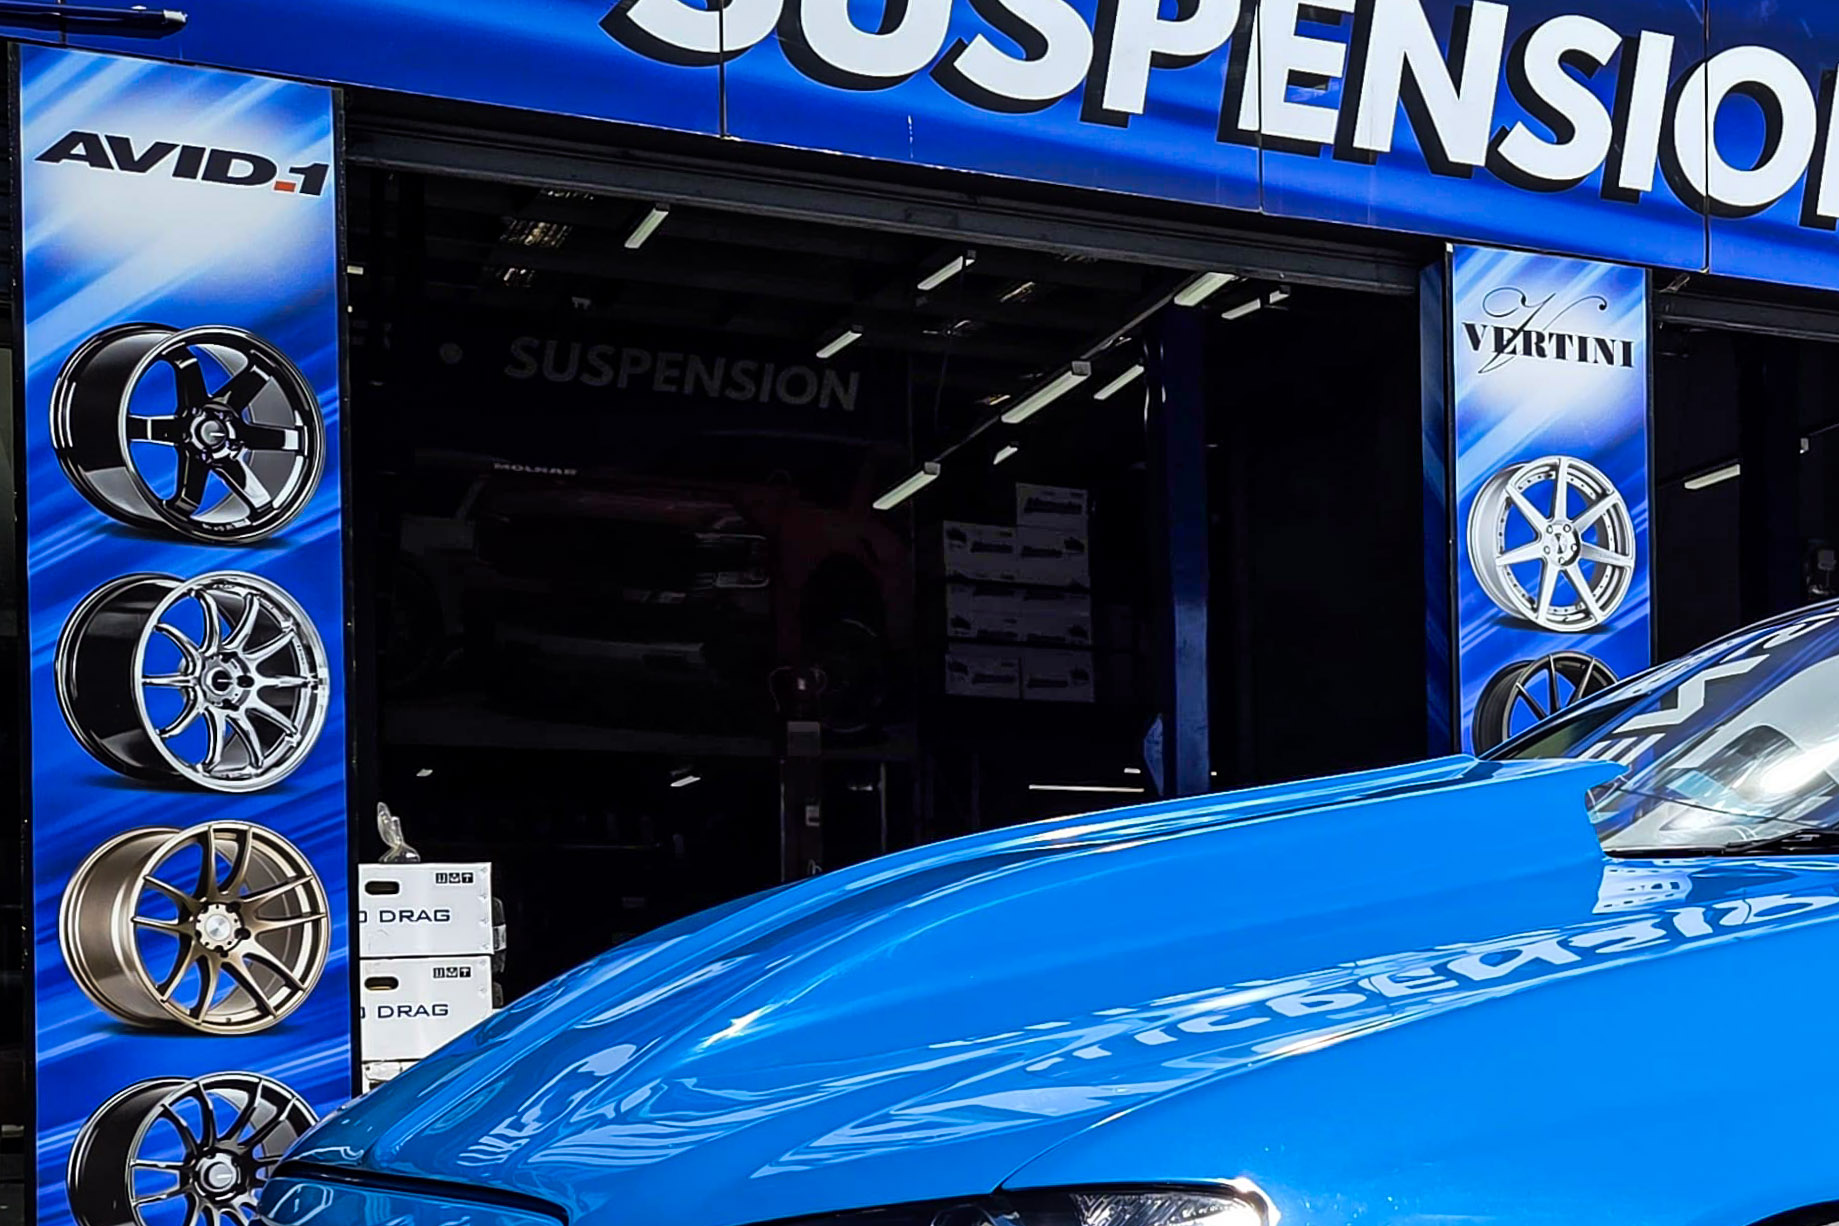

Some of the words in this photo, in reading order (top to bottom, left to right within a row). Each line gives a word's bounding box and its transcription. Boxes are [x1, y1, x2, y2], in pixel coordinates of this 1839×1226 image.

[34, 130, 330, 197] AVID.1
[1462, 321, 1635, 369] VERTINI
[503, 335, 861, 413] SUSPENSION
[379, 909, 450, 923] DRAG
[377, 1003, 449, 1019] DRAG
